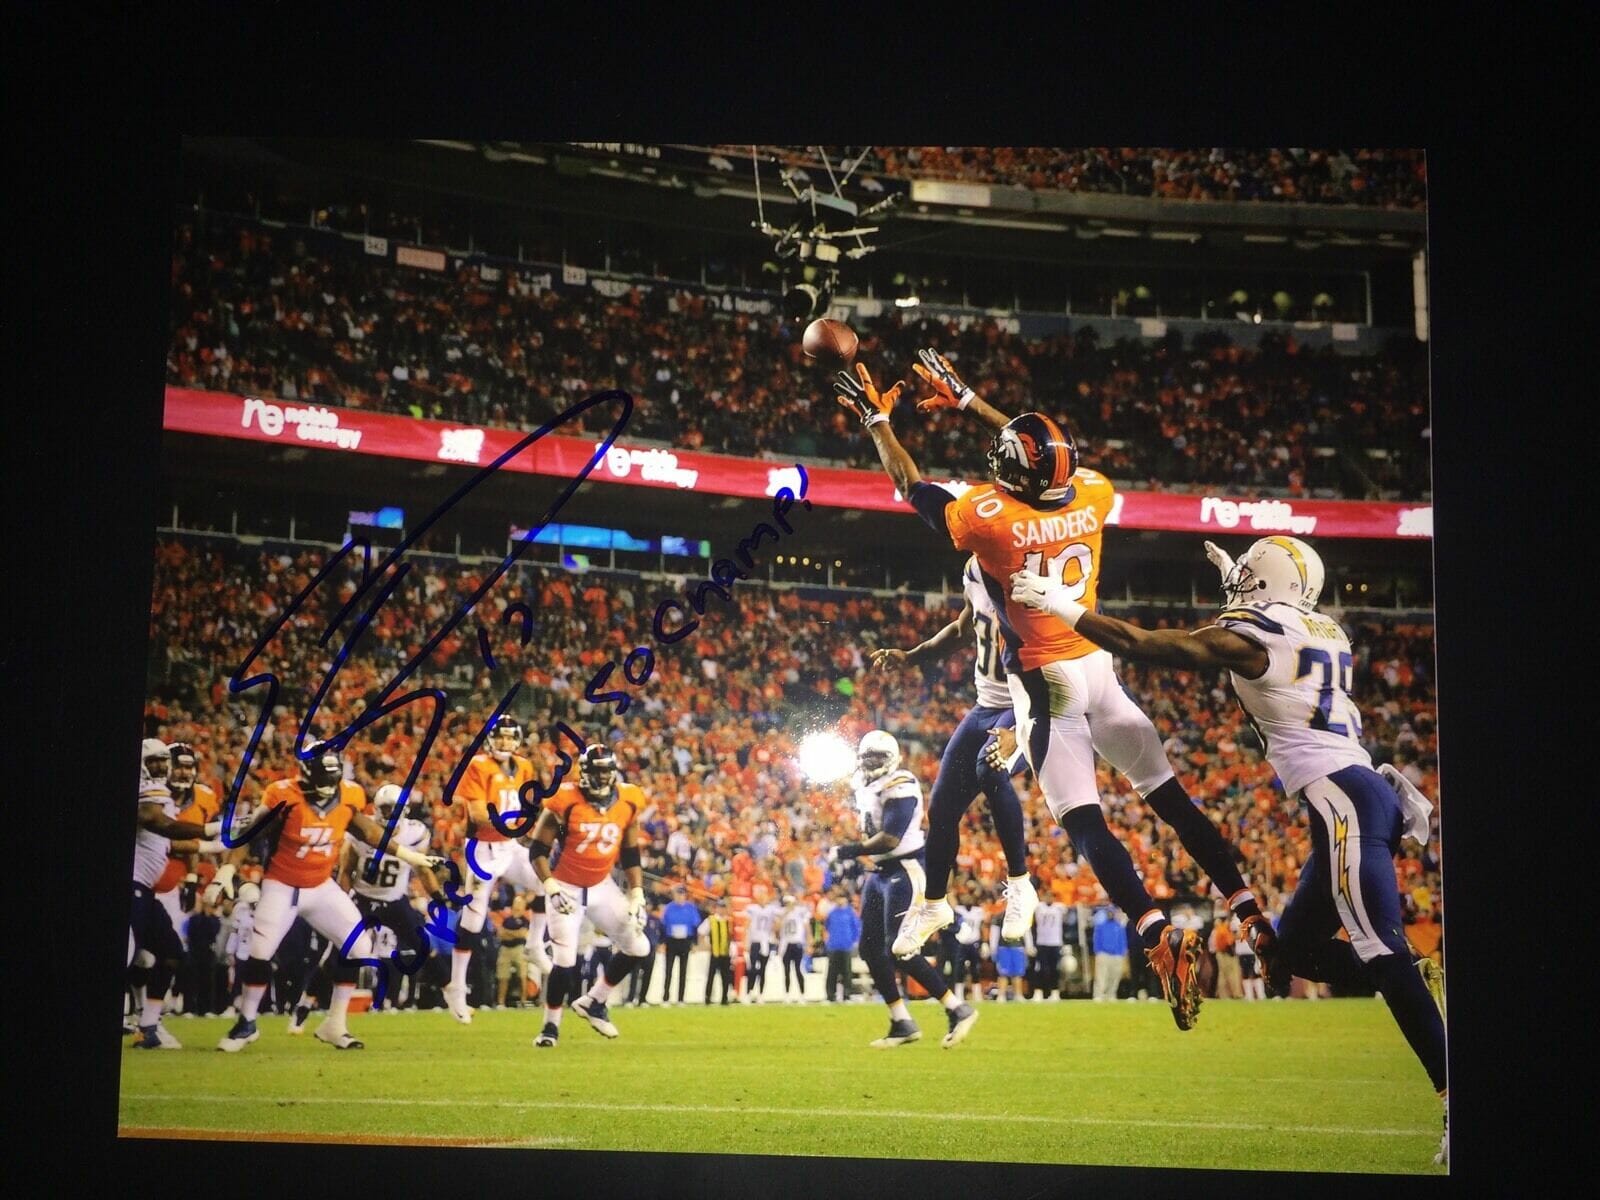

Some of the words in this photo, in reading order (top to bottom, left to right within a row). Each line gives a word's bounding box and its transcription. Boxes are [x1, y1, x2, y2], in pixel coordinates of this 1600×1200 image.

[971, 489, 1005, 520] 10
[1011, 506, 1099, 548] SANDERS
[585, 647, 656, 715] 50
[295, 827, 334, 859] 74
[574, 822, 621, 855] 79
